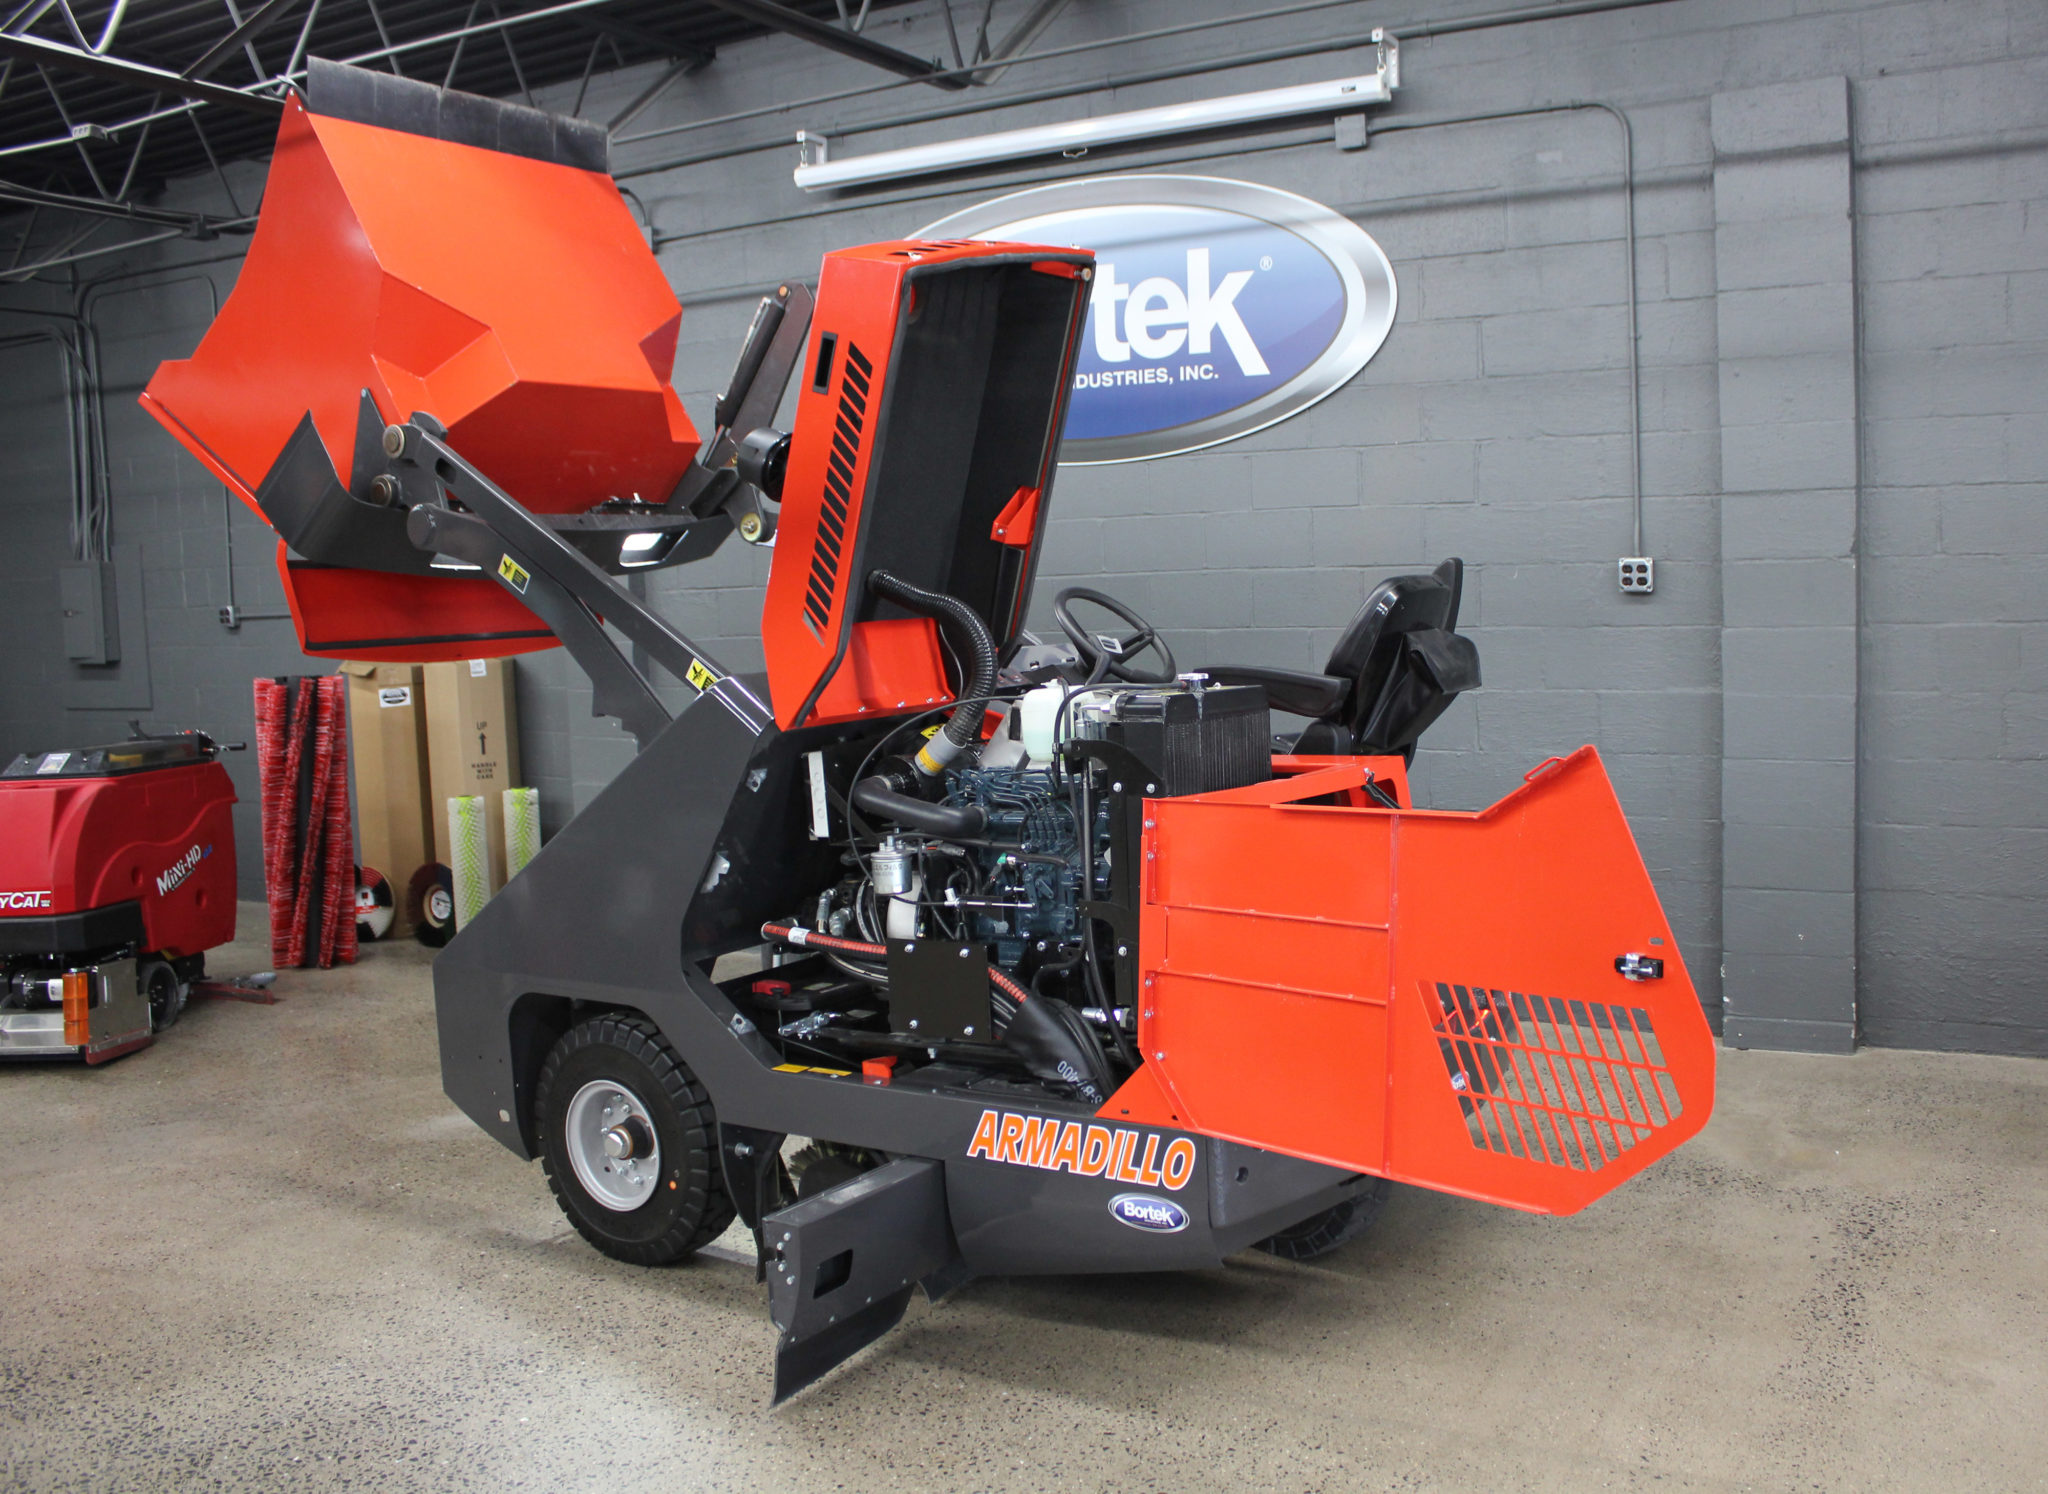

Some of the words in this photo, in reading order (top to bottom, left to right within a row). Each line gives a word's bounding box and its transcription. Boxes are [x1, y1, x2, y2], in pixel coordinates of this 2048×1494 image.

[1090, 248, 1271, 376] tek
[1073, 366, 1174, 390] DUSTRIES,
[1179, 363, 1219, 382] INC.
[476, 721, 488, 731] UP
[966, 1109, 1196, 1191] ARMADILLO
[1123, 1200, 1175, 1227] Bortek
